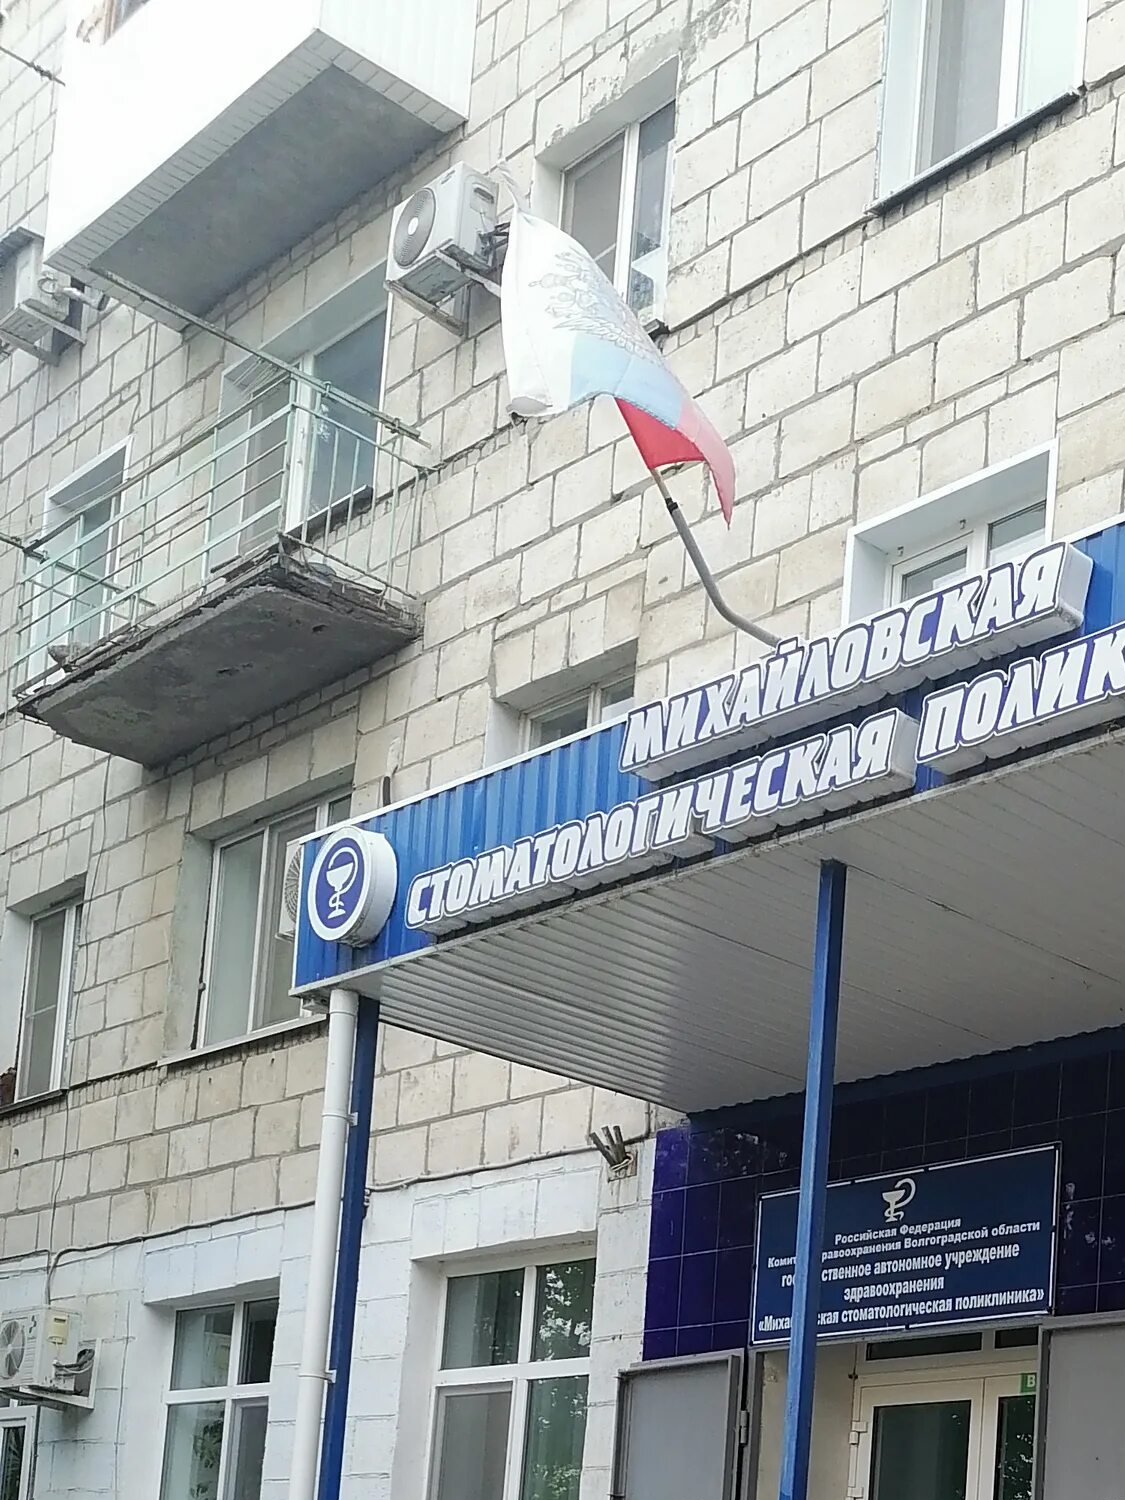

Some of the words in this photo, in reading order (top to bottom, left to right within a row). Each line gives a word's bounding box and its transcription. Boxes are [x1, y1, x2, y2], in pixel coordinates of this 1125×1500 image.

[621, 544, 1066, 767] МИХАЙЛОВСКАЯ
[407, 713, 896, 926] СТОМАТОЛОГИЧЕСКАЯ
[768, 1256, 797, 1269] Комит
[821, 1241, 901, 1262] равоохранения
[904, 1229, 988, 1248] Волгоградской
[992, 1222, 1040, 1236] области
[834, 1228, 897, 1246] Российская
[900, 1219, 961, 1235] Федерация
[874, 1253, 942, 1276] автономное
[944, 1243, 1020, 1270] учреждение
[841, 1298, 952, 1323] стоматологическая
[955, 1288, 1045, 1310] поликлиника»
[843, 1276, 944, 1303] здравоохранения
